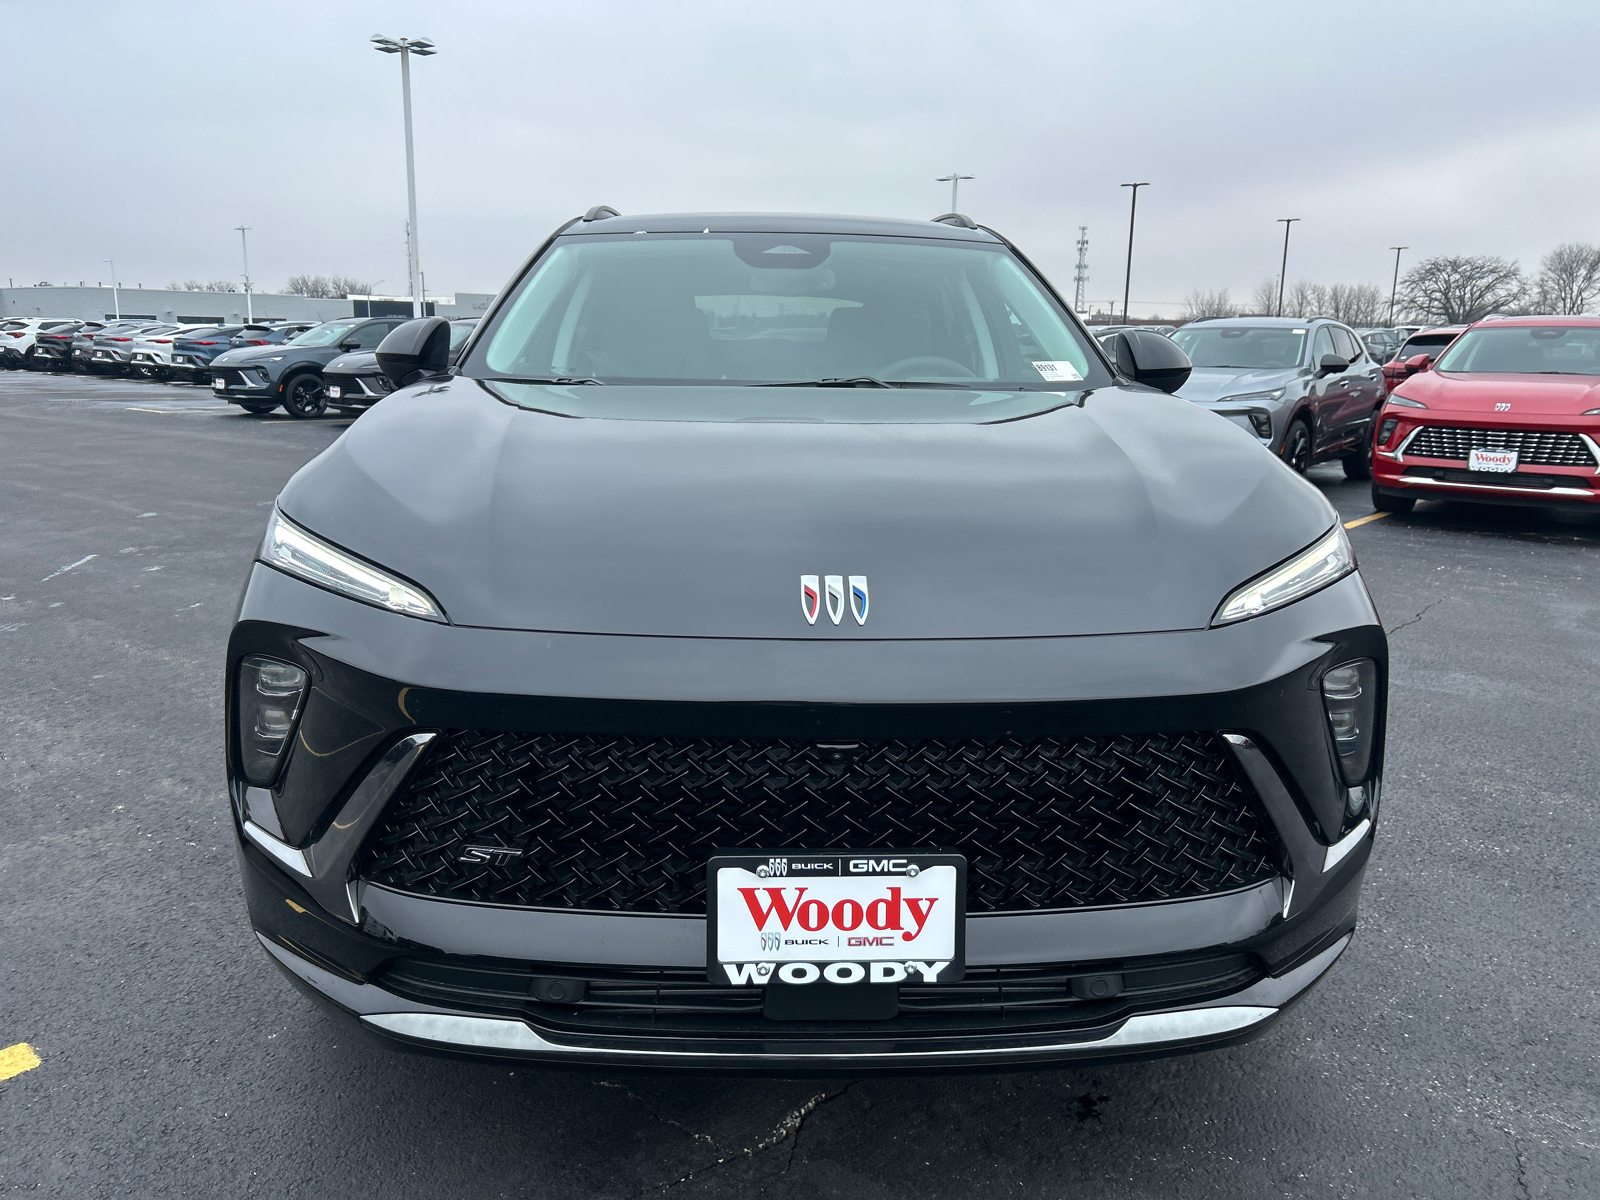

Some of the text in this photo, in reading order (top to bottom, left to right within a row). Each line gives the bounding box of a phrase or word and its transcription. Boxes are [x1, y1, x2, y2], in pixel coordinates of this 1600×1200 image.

[1475, 453, 1514, 466] Woody
[457, 844, 523, 867] ST
[792, 859, 908, 873] BUICK GMC
[737, 886, 939, 942] Woody
[784, 936, 895, 947] BUICK GMC
[722, 961, 951, 985] WOODY
